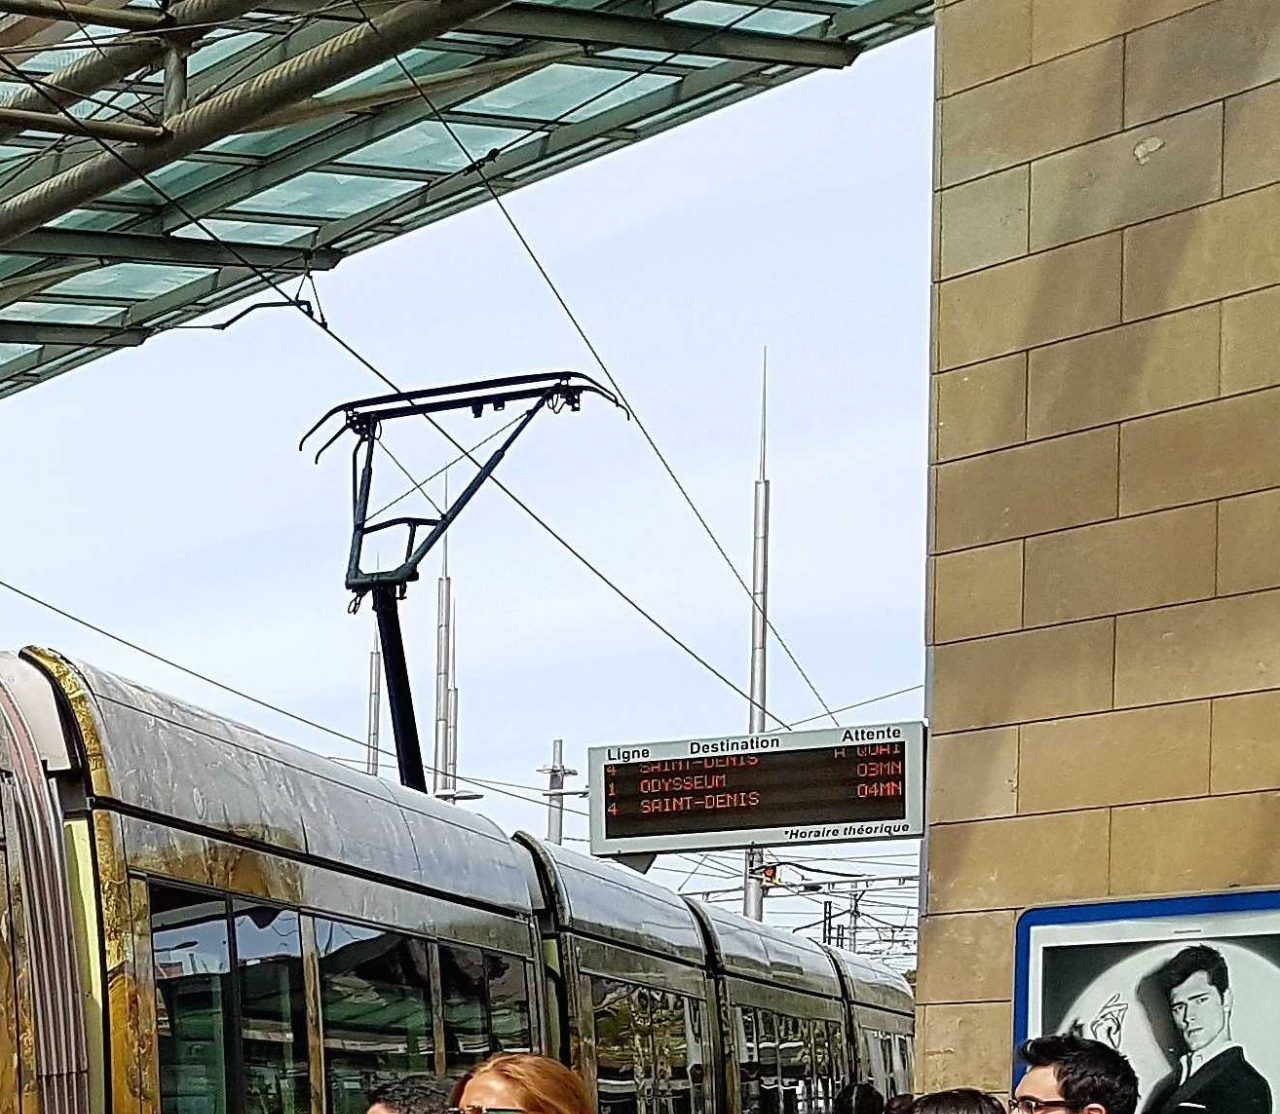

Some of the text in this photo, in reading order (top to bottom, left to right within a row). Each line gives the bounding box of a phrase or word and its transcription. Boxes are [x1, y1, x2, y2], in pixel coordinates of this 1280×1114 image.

[842, 727, 901, 742] Attente
[690, 737, 780, 755] Destination
[607, 748, 650, 763] Ligne
[856, 761, 902, 777] 03MN
[608, 784, 617, 796] 1
[639, 774, 726, 793] ODYSSEUM
[857, 781, 902, 798] 04MN
[608, 802, 619, 816] 4
[639, 792, 760, 814] SAINT-DENIS
[843, 823, 910, 839] théorique
